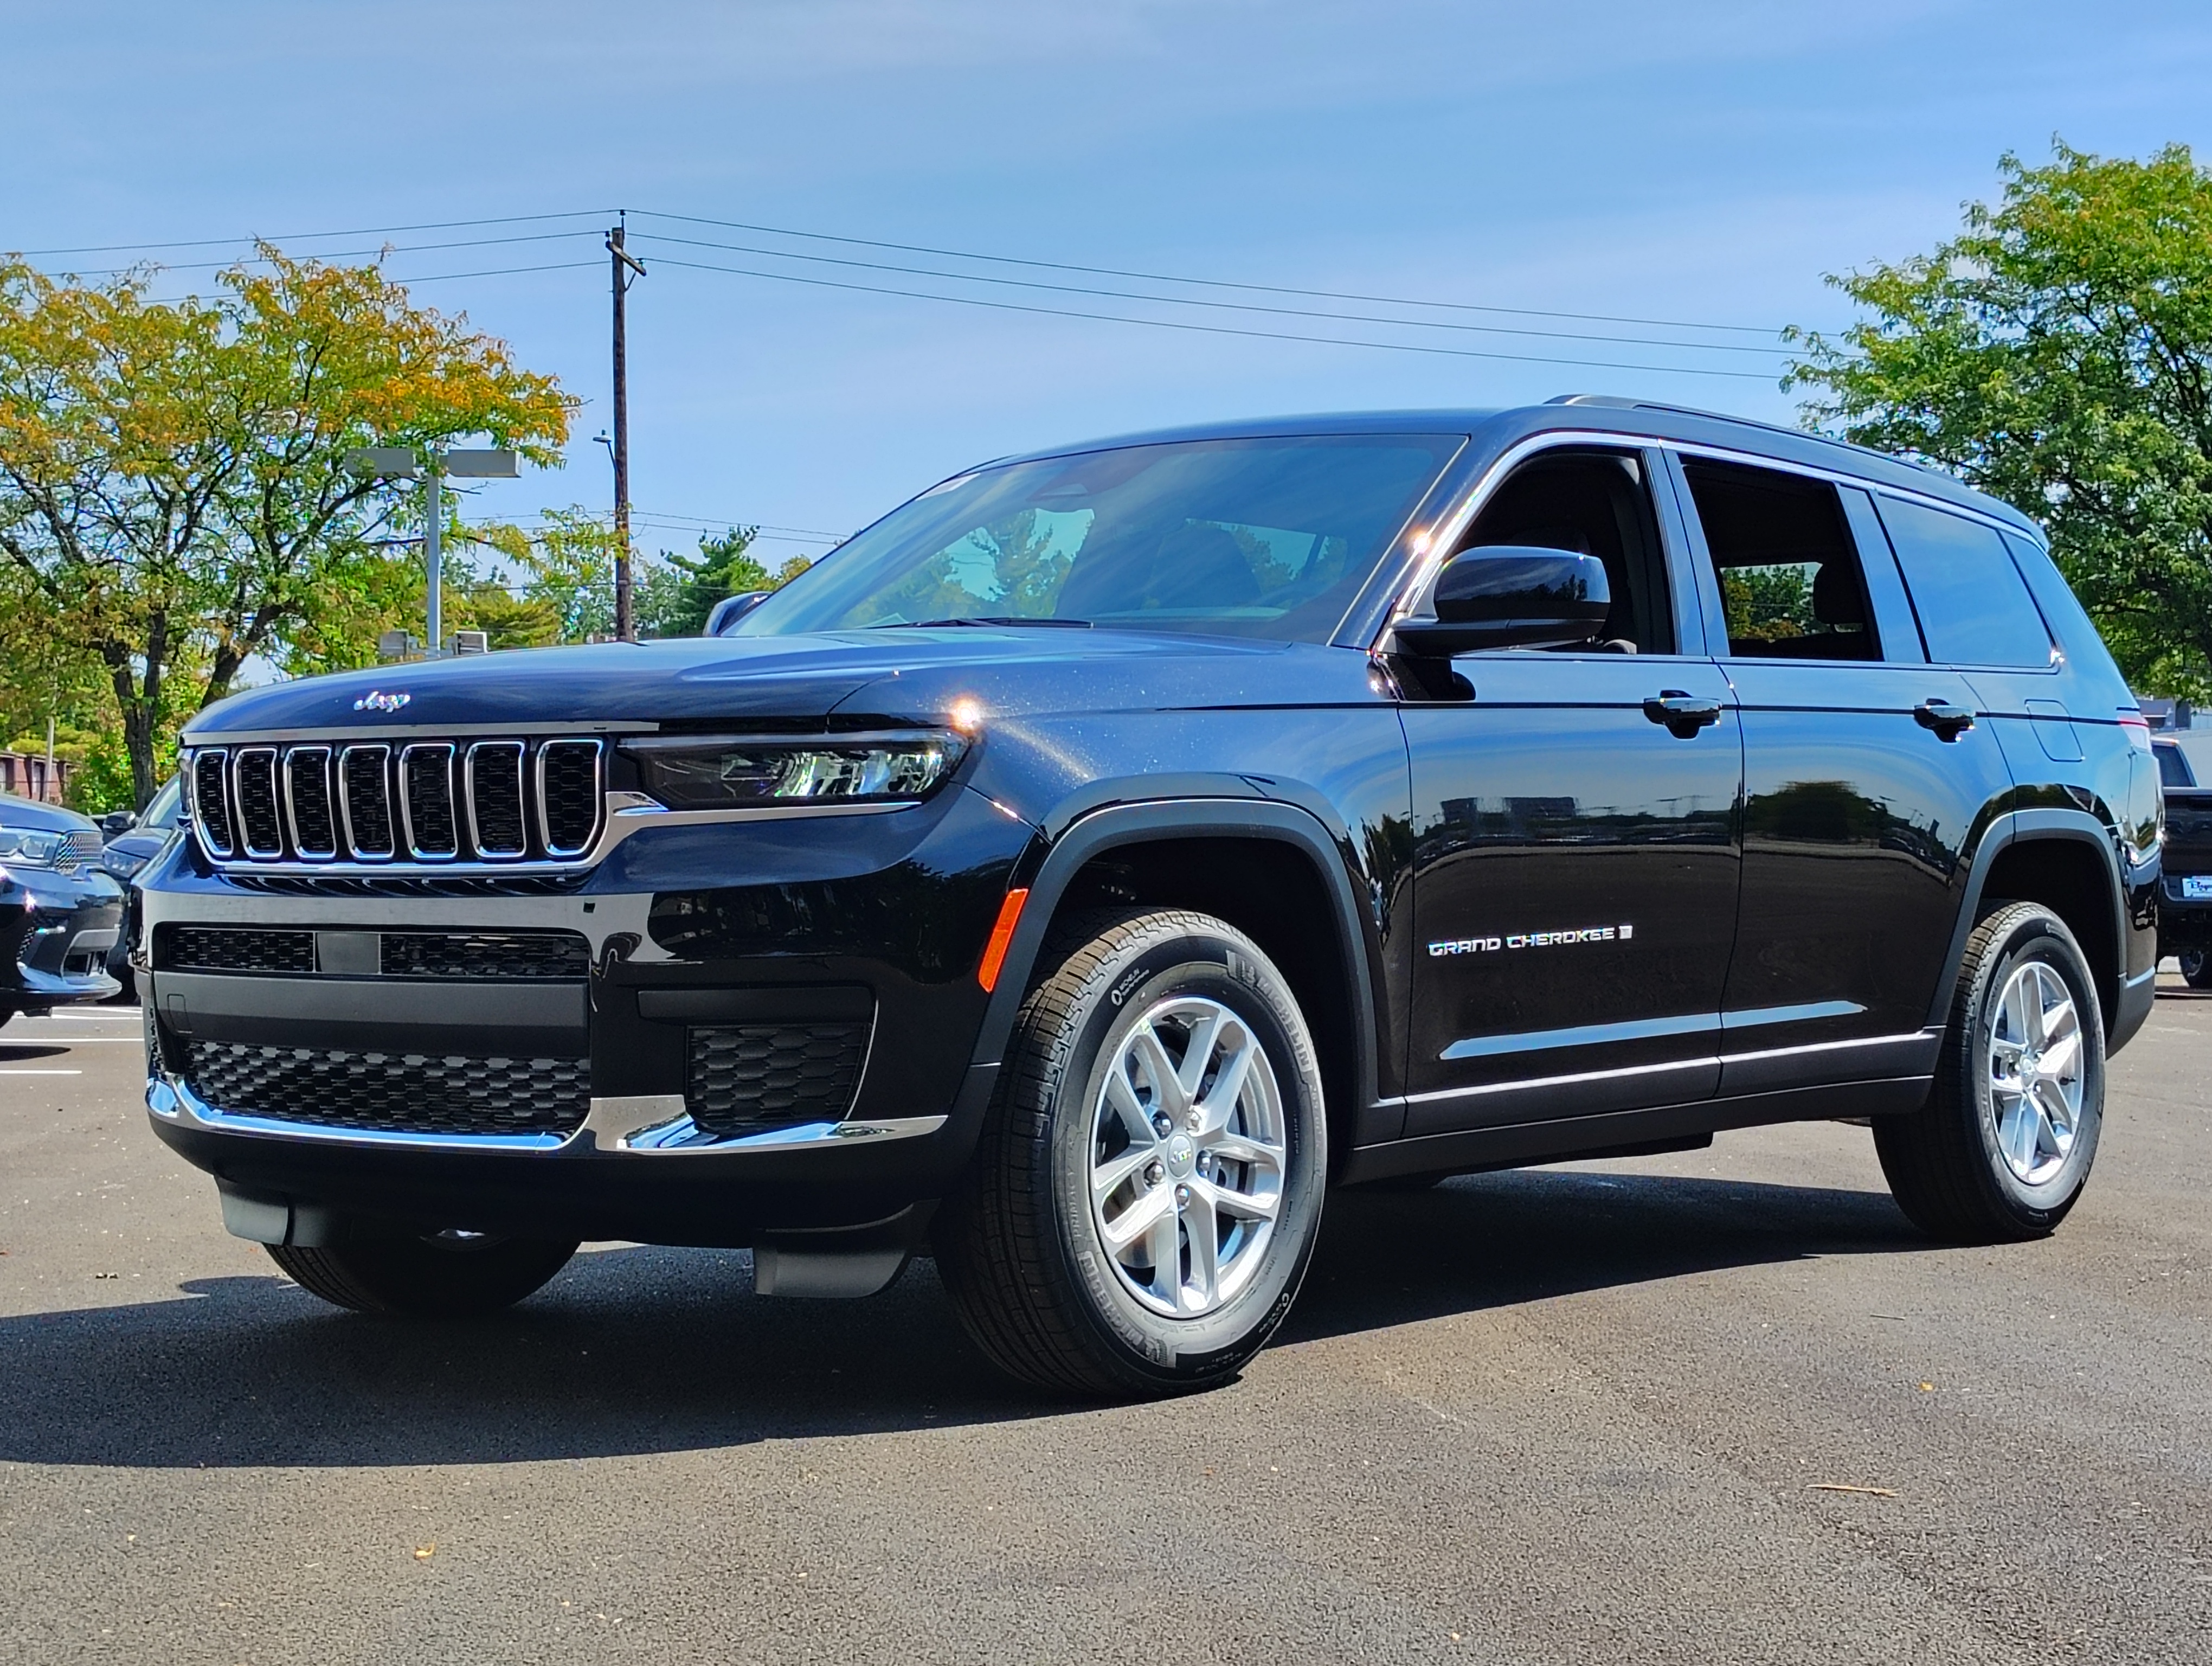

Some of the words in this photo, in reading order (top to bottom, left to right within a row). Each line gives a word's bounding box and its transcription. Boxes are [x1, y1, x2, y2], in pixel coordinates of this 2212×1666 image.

[1427, 938, 1501, 956] GRAND
[1506, 927, 1615, 949] CHEROKEE
[1080, 1256, 1143, 1347] MICHELIN
